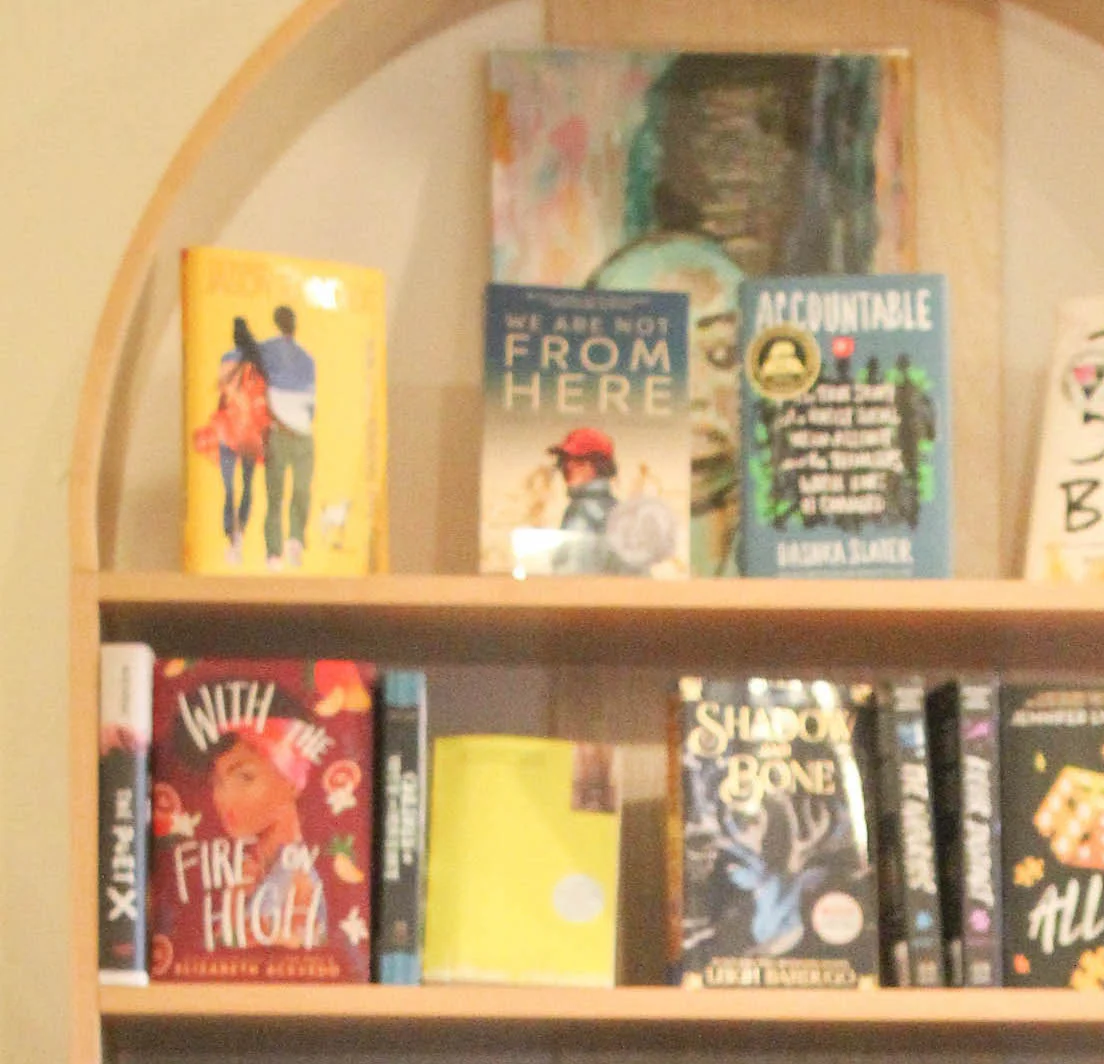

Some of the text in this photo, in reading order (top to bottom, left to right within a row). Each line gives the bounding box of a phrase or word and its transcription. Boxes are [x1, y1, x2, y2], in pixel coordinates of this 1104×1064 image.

[754, 289, 934, 333] ACCOUNTABLE
[504, 333, 672, 375] FROM
[503, 371, 674, 416] HERE
[177, 679, 276, 752] WITH
[718, 753, 837, 814] BONE
[172, 835, 259, 905] FIRE
[202, 880, 324, 952] HIGH
